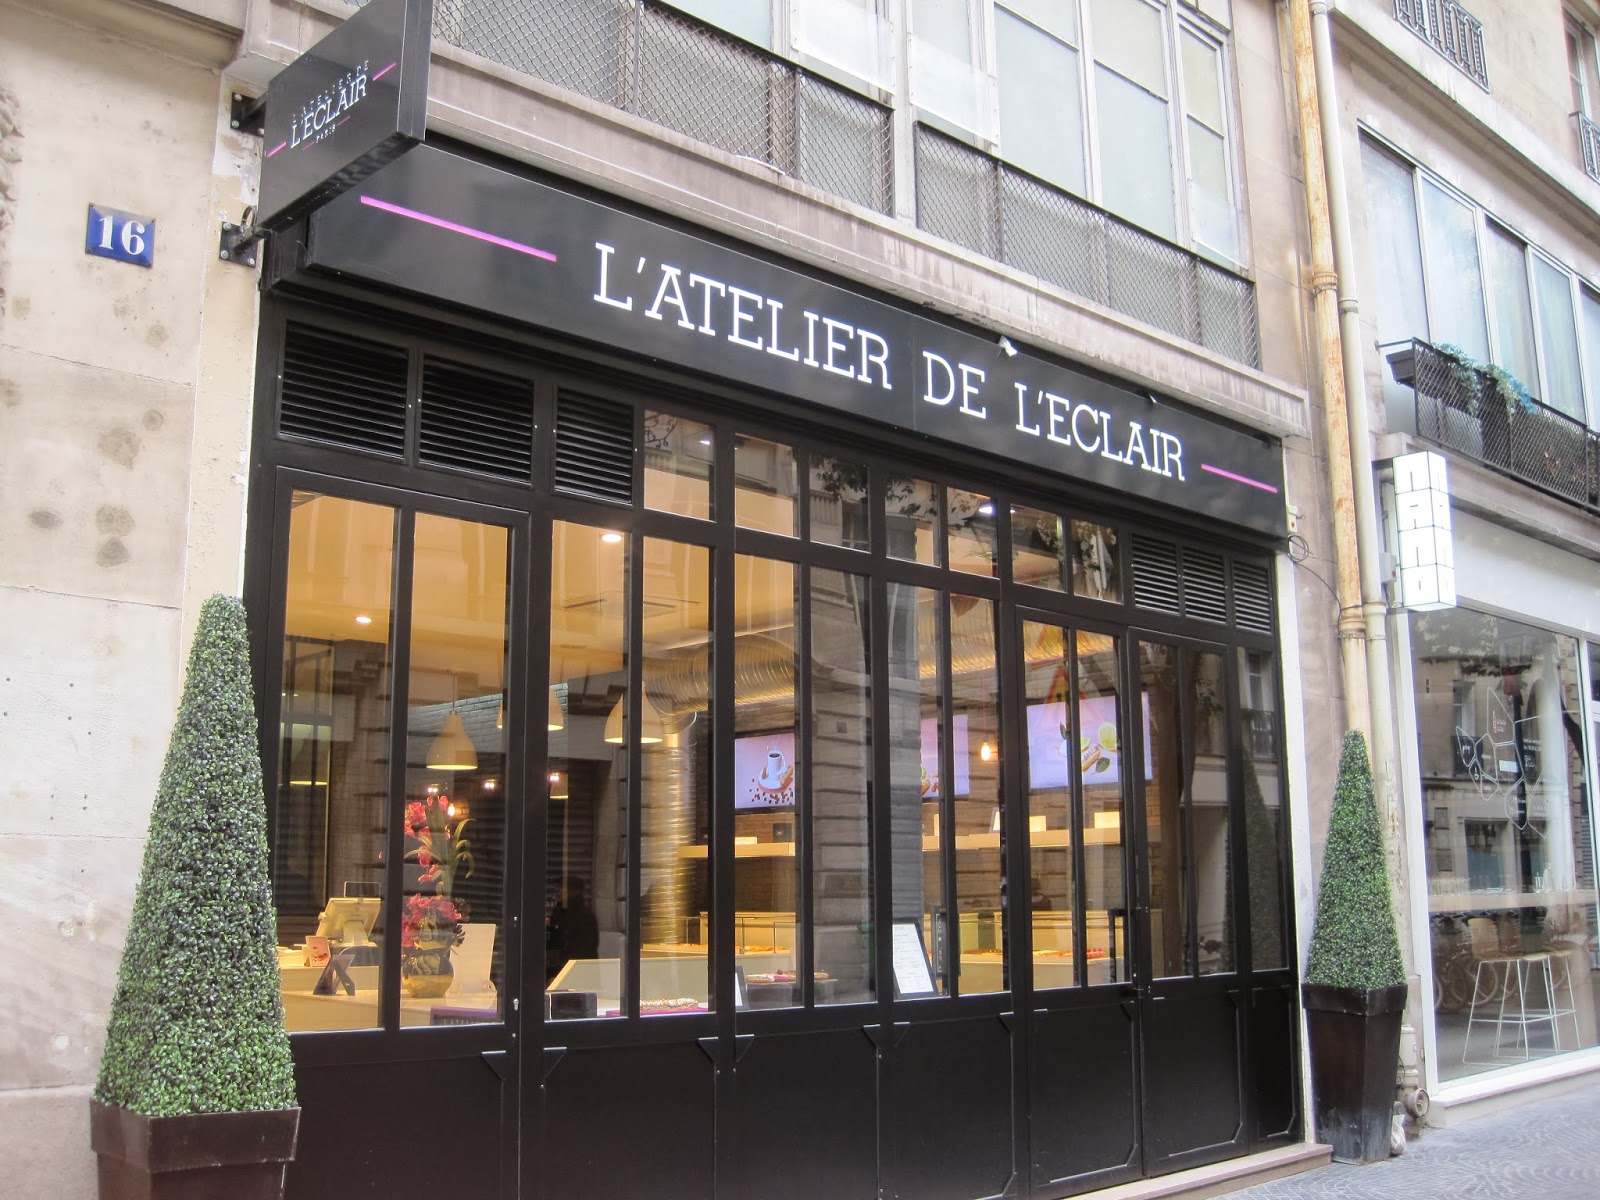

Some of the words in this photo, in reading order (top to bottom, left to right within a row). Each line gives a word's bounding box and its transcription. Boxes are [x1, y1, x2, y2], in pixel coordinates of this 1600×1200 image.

[291, 74, 367, 149] L'ECLAIR
[99, 215, 146, 256] 16
[593, 241, 893, 391] L'ATELIER
[923, 350, 988, 420] DE
[1013, 382, 1186, 482] L'ECLAIR
